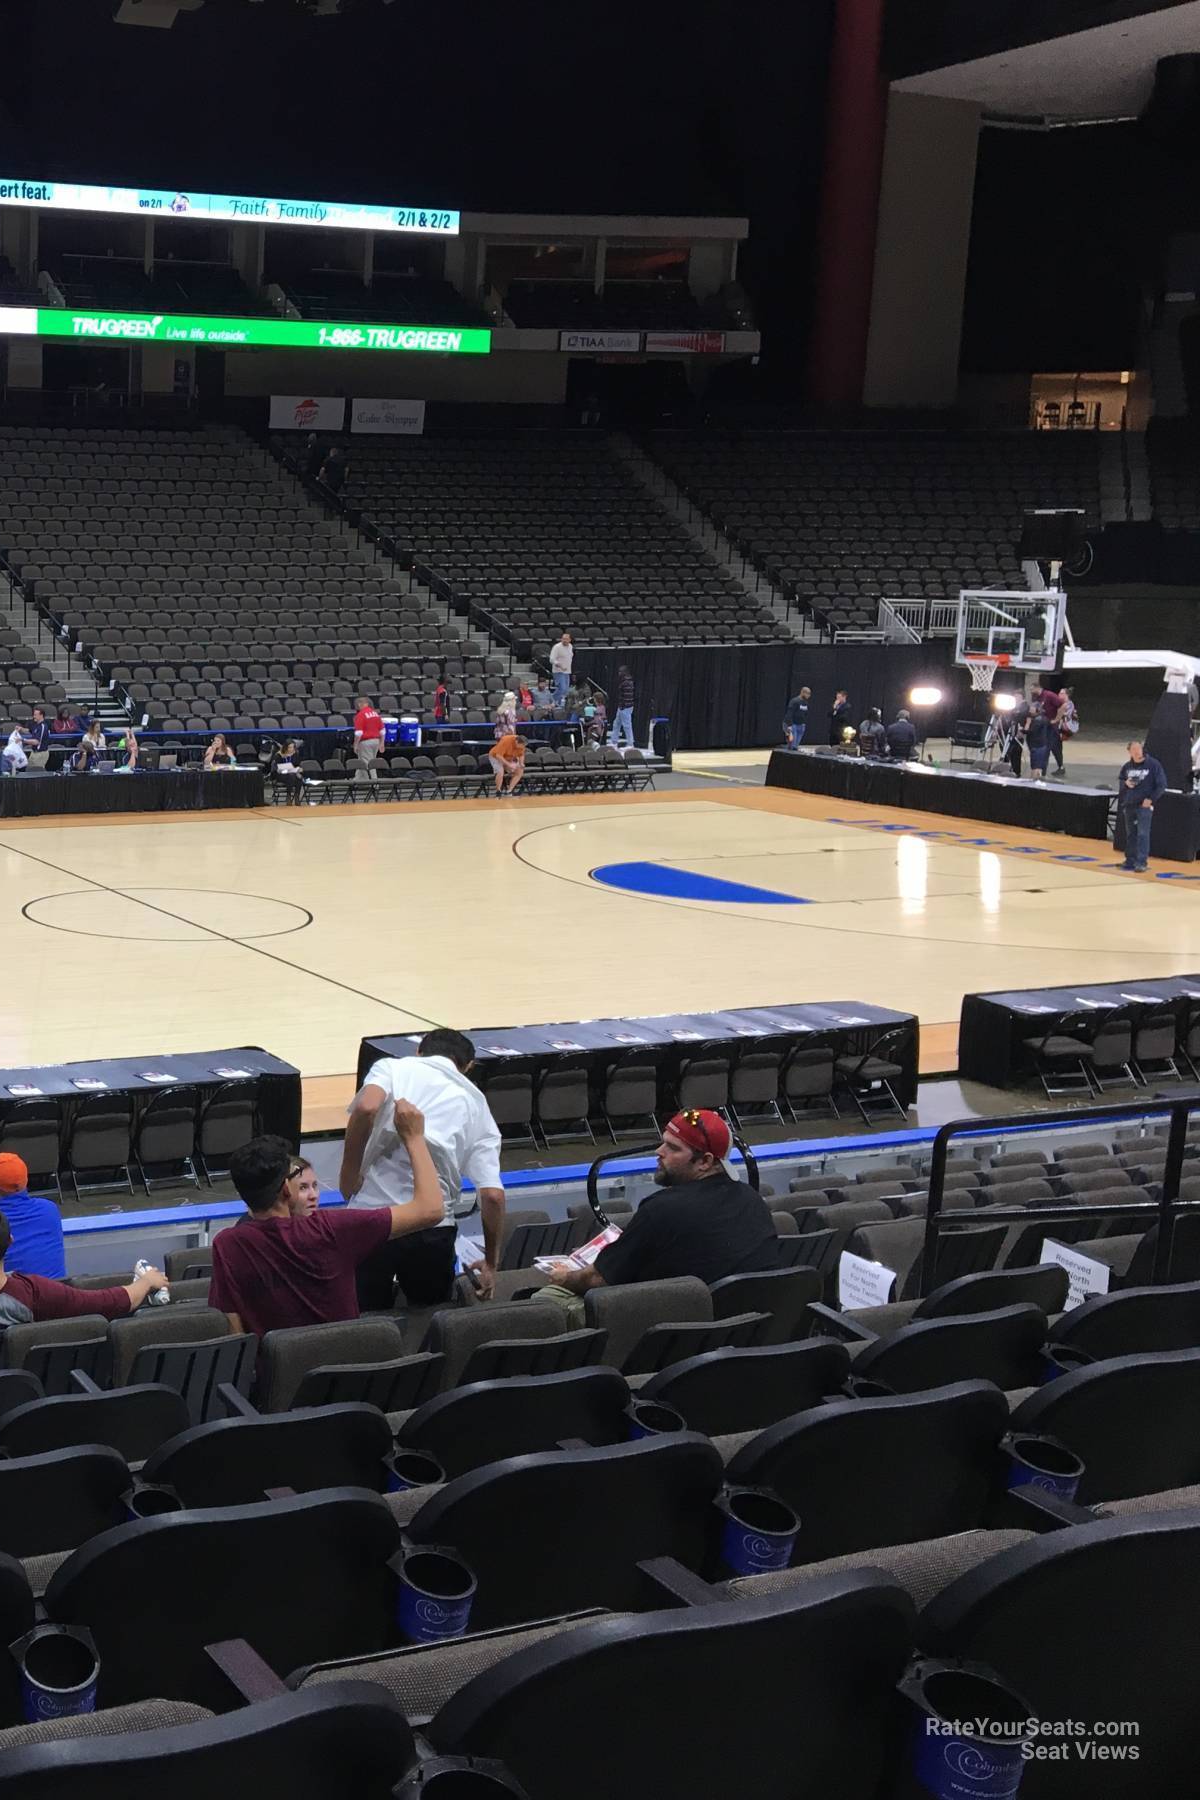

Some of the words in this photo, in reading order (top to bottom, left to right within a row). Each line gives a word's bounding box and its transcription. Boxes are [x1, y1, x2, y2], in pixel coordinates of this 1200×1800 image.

[21, 182, 51, 200] feat.
[139, 199, 150, 208] on
[150, 198, 162, 209] 2/1
[229, 199, 270, 217] Faith
[276, 202, 327, 222] Family
[398, 211, 417, 227] 2/1
[418, 213, 428, 228] &
[431, 213, 451, 229] 2/2
[72, 317, 156, 338] TRUGREEN
[166, 327, 187, 339] Live
[190, 327, 205, 340] life
[580, 337, 605, 348] TIAA
[851, 1263, 881, 1281] Reserved
[1055, 1254, 1092, 1275] Reserved
